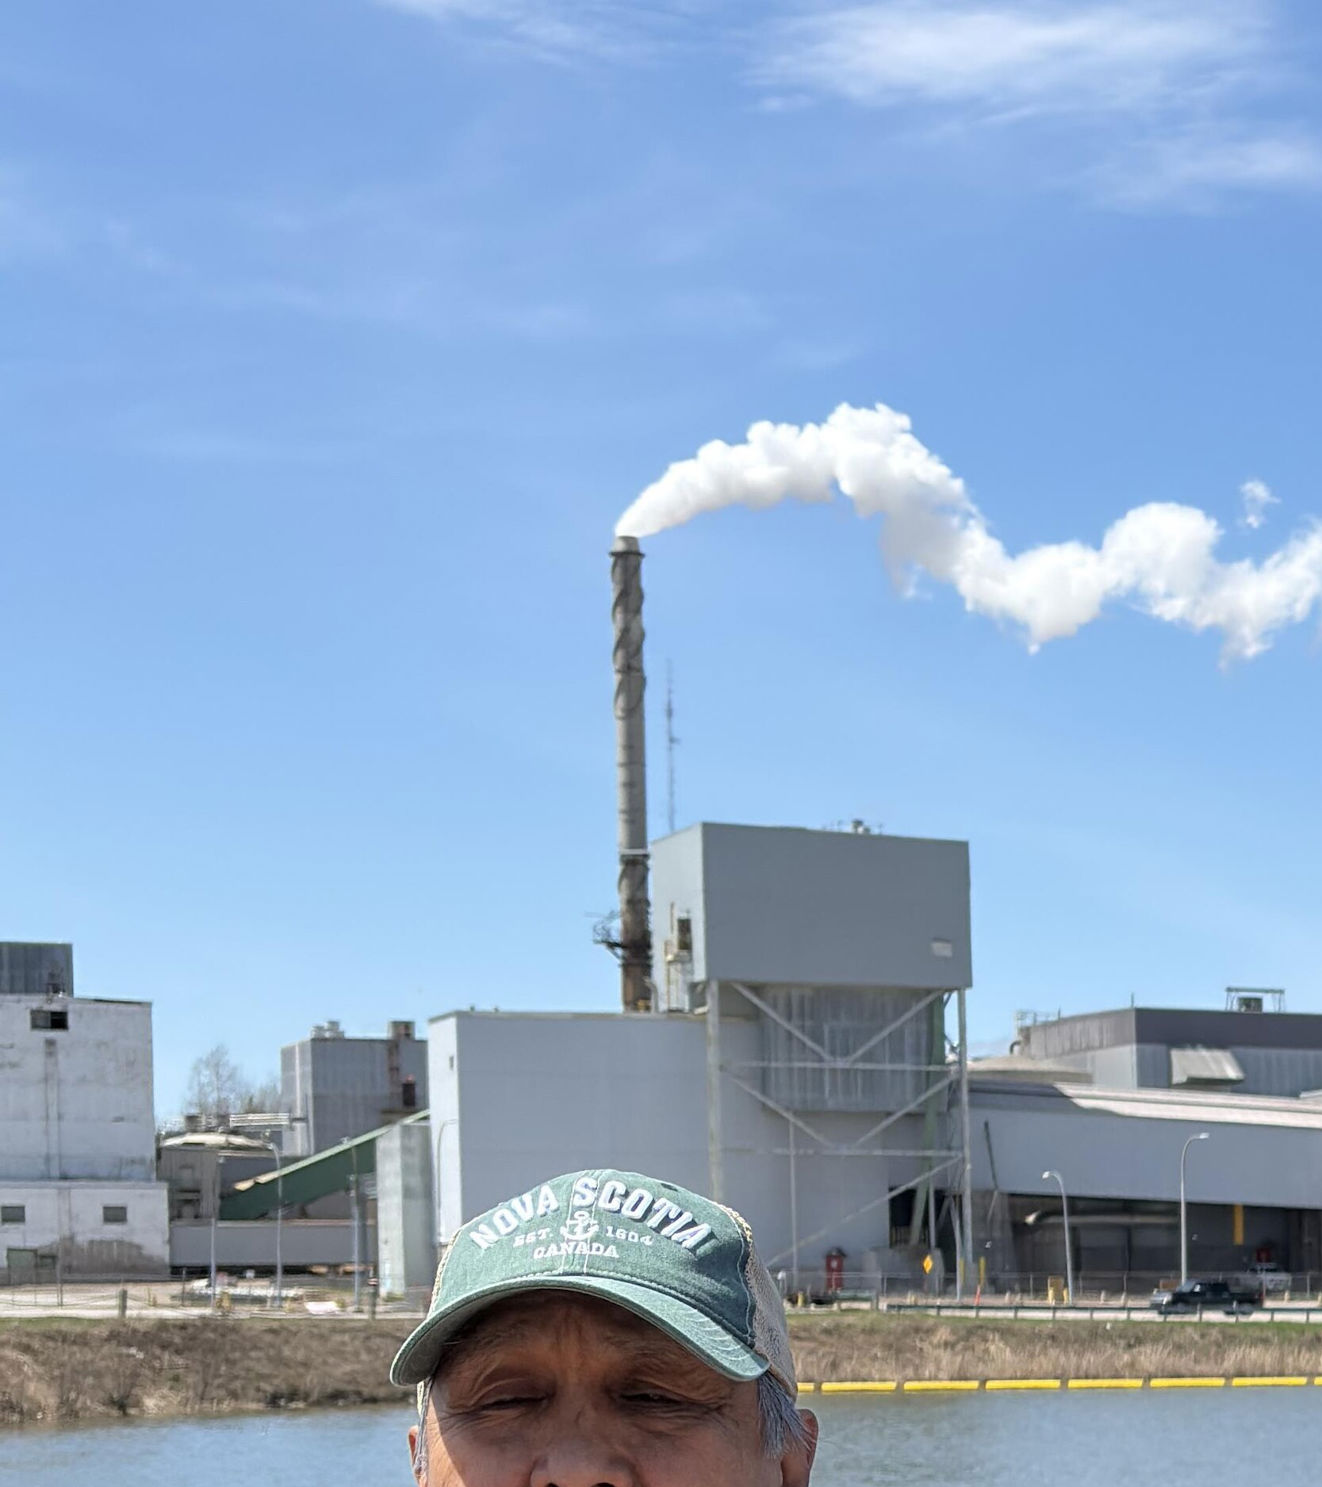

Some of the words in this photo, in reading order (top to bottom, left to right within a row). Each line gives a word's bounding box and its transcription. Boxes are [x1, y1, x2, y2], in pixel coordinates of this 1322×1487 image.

[469, 1184, 560, 1250] NOVA
[574, 1176, 713, 1249] SCOTIA
[533, 1241, 620, 1260] CANADA
